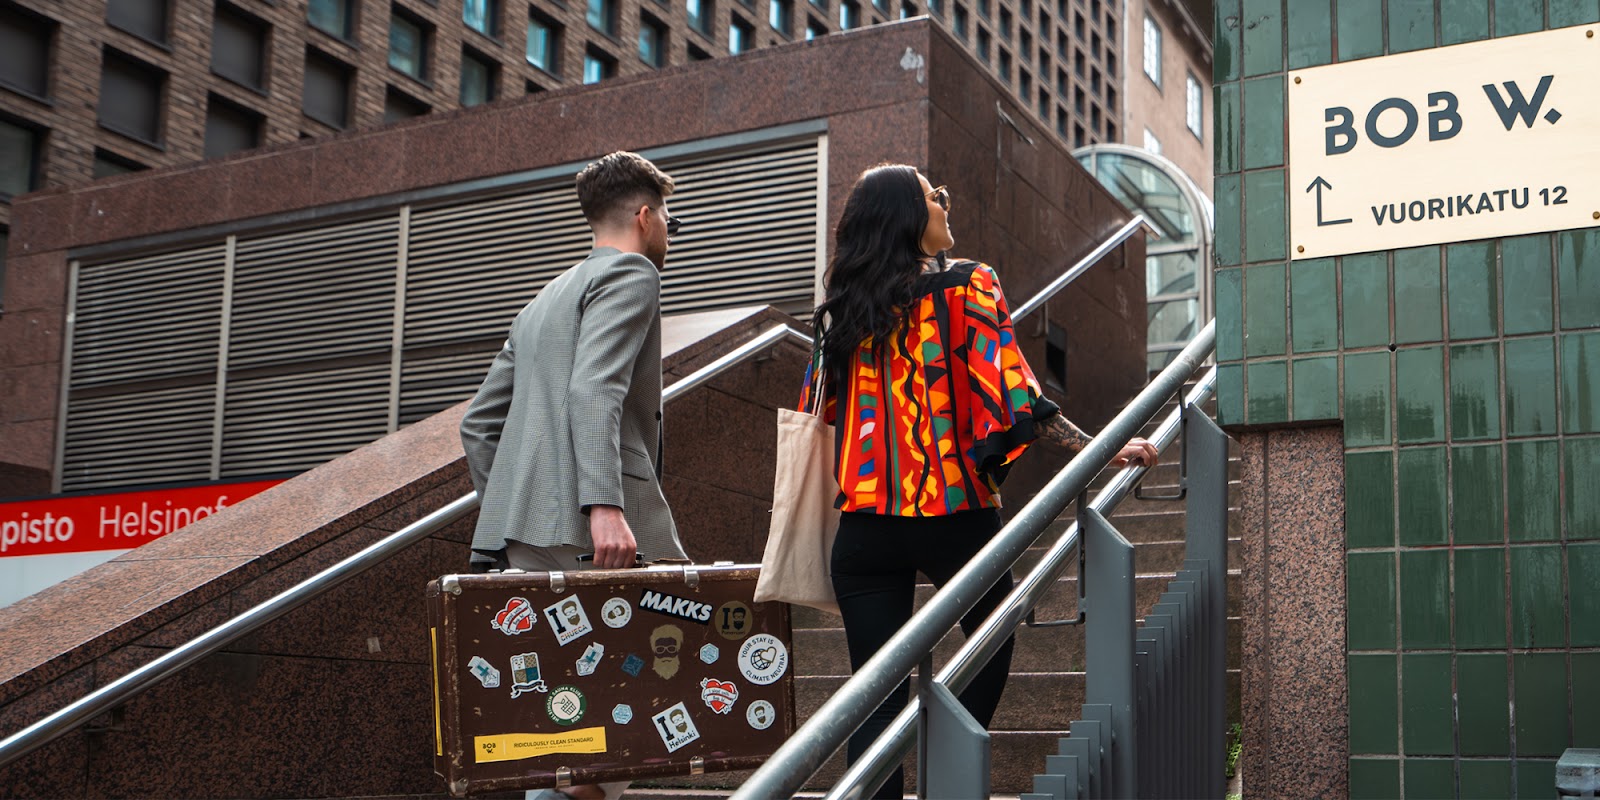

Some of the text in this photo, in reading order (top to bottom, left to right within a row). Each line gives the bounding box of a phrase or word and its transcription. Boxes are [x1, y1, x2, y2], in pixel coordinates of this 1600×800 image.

[1325, 75, 1562, 156] BOB W.
[1371, 186, 1568, 226] VUORIKATU 12
[0, 511, 74, 552] pisto
[640, 591, 712, 621] MAKKS
[548, 608, 566, 634] I
[561, 625, 588, 642] CHUECA
[742, 642, 752, 658] YOUR
[751, 637, 766, 645] STAY
[745, 653, 785, 681] CLIMATE NEUTRAL
[657, 716, 675, 741] I
[668, 730, 696, 749] Helsinki
[513, 740, 549, 748] RIDICULOUSLY
[567, 736, 594, 744] STANDARD
